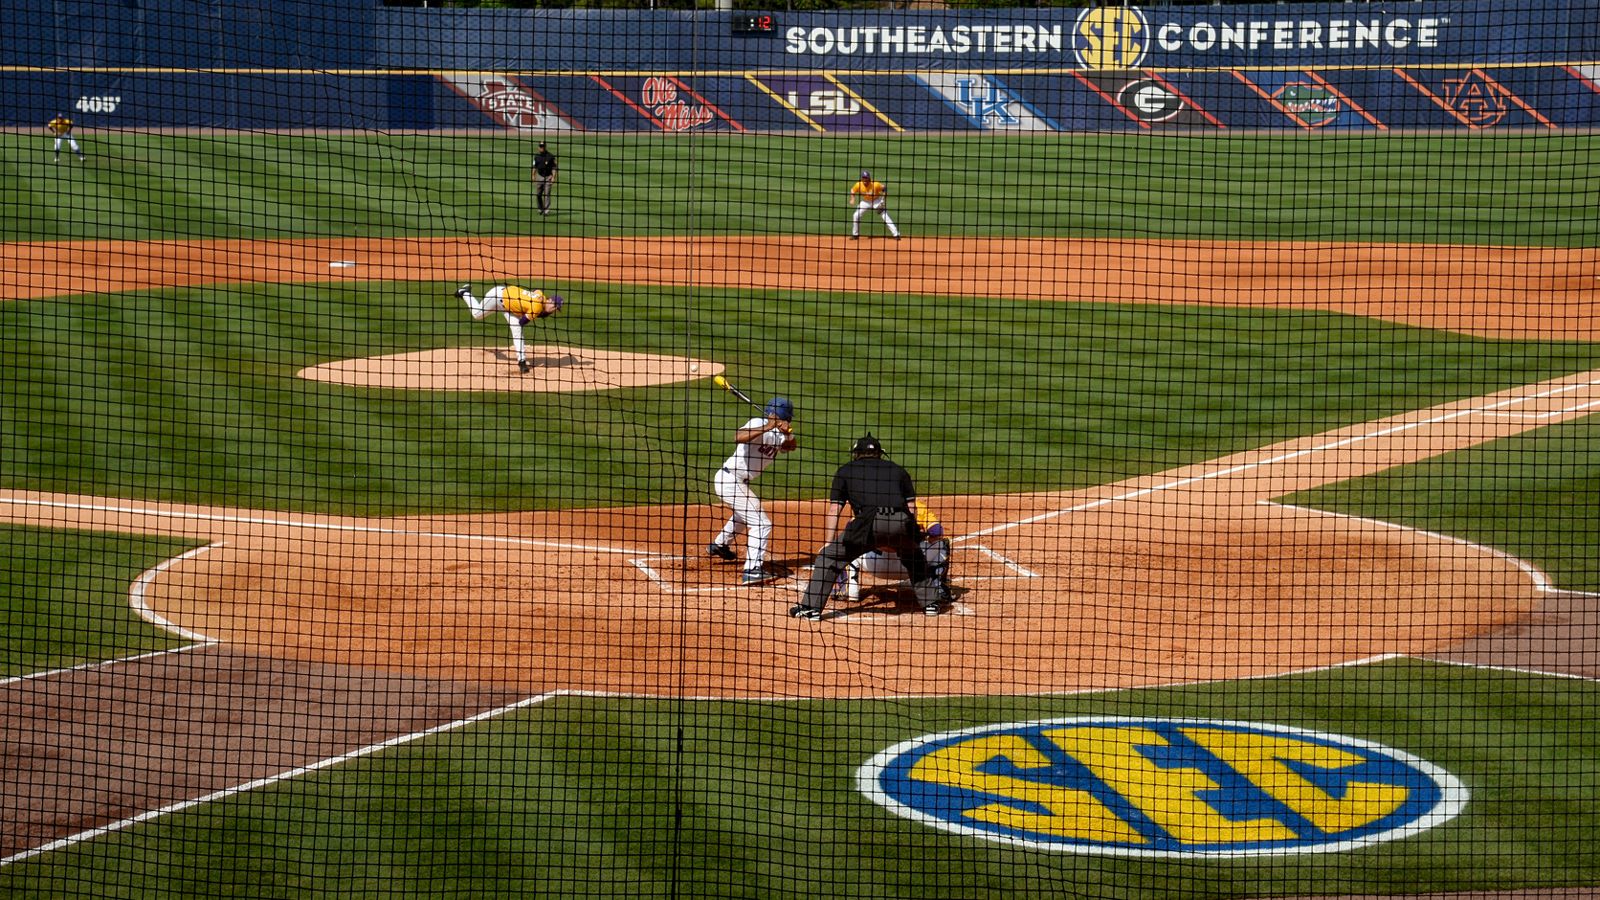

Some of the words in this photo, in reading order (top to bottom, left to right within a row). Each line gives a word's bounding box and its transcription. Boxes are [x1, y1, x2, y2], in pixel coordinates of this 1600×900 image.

[785, 25, 1061, 54] SOUTHEASTERN
[1079, 6, 1142, 70] SEC
[1158, 18, 1438, 51] CONFERENCE
[488, 94, 535, 110] STATE
[642, 77, 677, 108] Ole
[787, 90, 861, 116] LSU
[1134, 86, 1178, 113] G
[655, 99, 714, 131] Miss
[907, 726, 1409, 844] SEC
